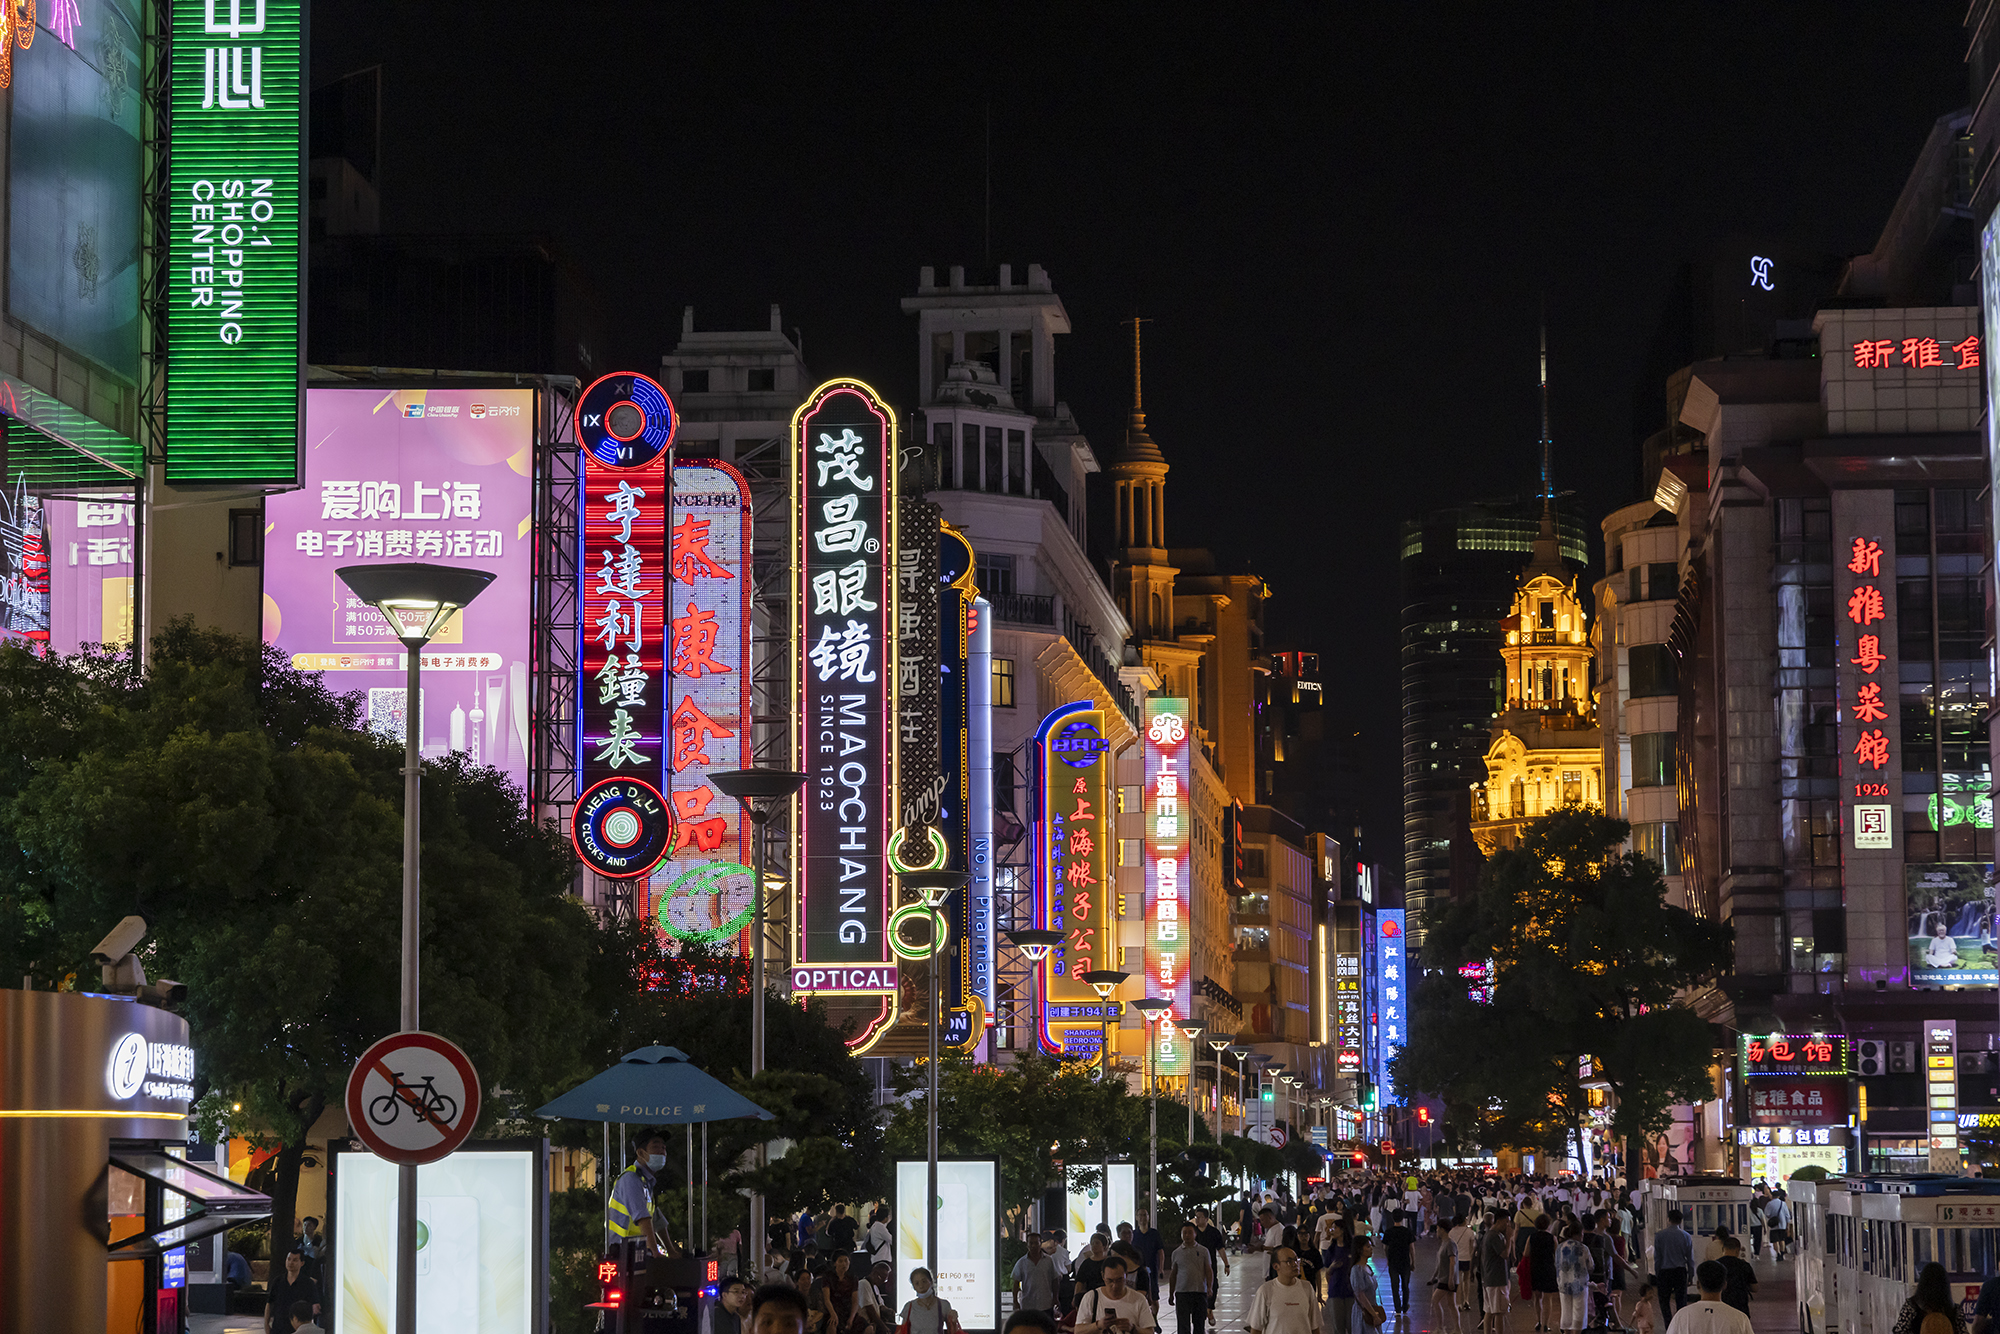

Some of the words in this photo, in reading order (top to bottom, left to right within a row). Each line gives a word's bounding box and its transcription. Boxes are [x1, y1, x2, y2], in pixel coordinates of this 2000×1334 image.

[250, 179, 274, 247] NO.1
[191, 180, 215, 308] CENTER
[219, 179, 244, 345] SHOPPING
[488, 406, 520, 416] 云闪付
[583, 414, 601, 427] IX
[615, 447, 633, 460] VI
[321, 481, 481, 519] 爱购上海
[296, 530, 503, 557] 电子消费券活动
[808, 428, 878, 683] 茂昌眼镜
[377, 657, 394, 666] 搜索
[406, 657, 490, 667] 海电子消费券
[672, 513, 736, 853] 泰康食品
[1297, 680, 1322, 691] EDITION
[820, 694, 834, 754] SINCE
[1052, 738, 1110, 752] BAC
[584, 786, 620, 816] HENG
[820, 766, 834, 811] 1923
[1854, 783, 1889, 797] 1926
[582, 823, 605, 860] CLOCKS
[606, 856, 627, 866] AND
[1156, 754, 1178, 941] 上海市第一食品商店
[1051, 812, 1066, 977] 上海卧室用品有公司
[975, 896, 990, 996] Pharmacy
[794, 970, 895, 990] OPTICAL
[1160, 953, 1176, 984] First
[1050, 1006, 1118, 1017] 创建于194年
[1160, 989, 1176, 1062] Fodhall
[1345, 1001, 1360, 1048] 真丝大王
[1746, 1041, 1833, 1062] 汤包馆
[620, 1105, 682, 1116] POLICE
[1754, 1090, 1823, 1107] 新雅食品
[1959, 1207, 1995, 1216] 观光车
[599, 1262, 617, 1283] 序
